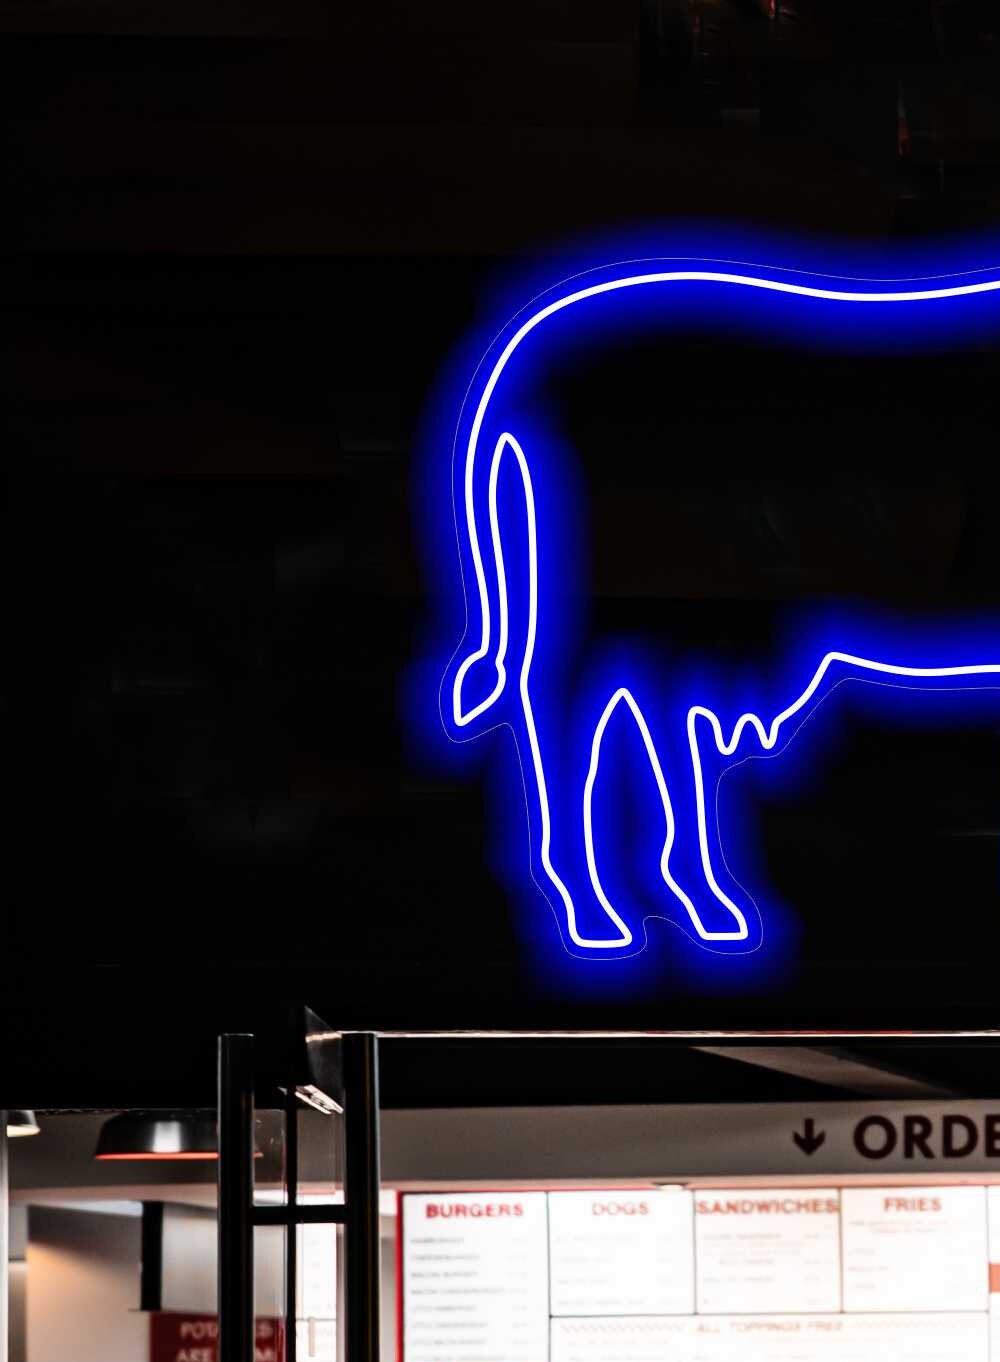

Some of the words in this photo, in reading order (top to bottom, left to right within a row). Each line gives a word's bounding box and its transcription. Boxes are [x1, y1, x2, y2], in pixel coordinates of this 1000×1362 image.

[426, 1202, 524, 1219] BURGERS
[592, 1201, 650, 1217] DOGS
[696, 1198, 840, 1216] SANDWICHES
[884, 1196, 942, 1213] FRIES
